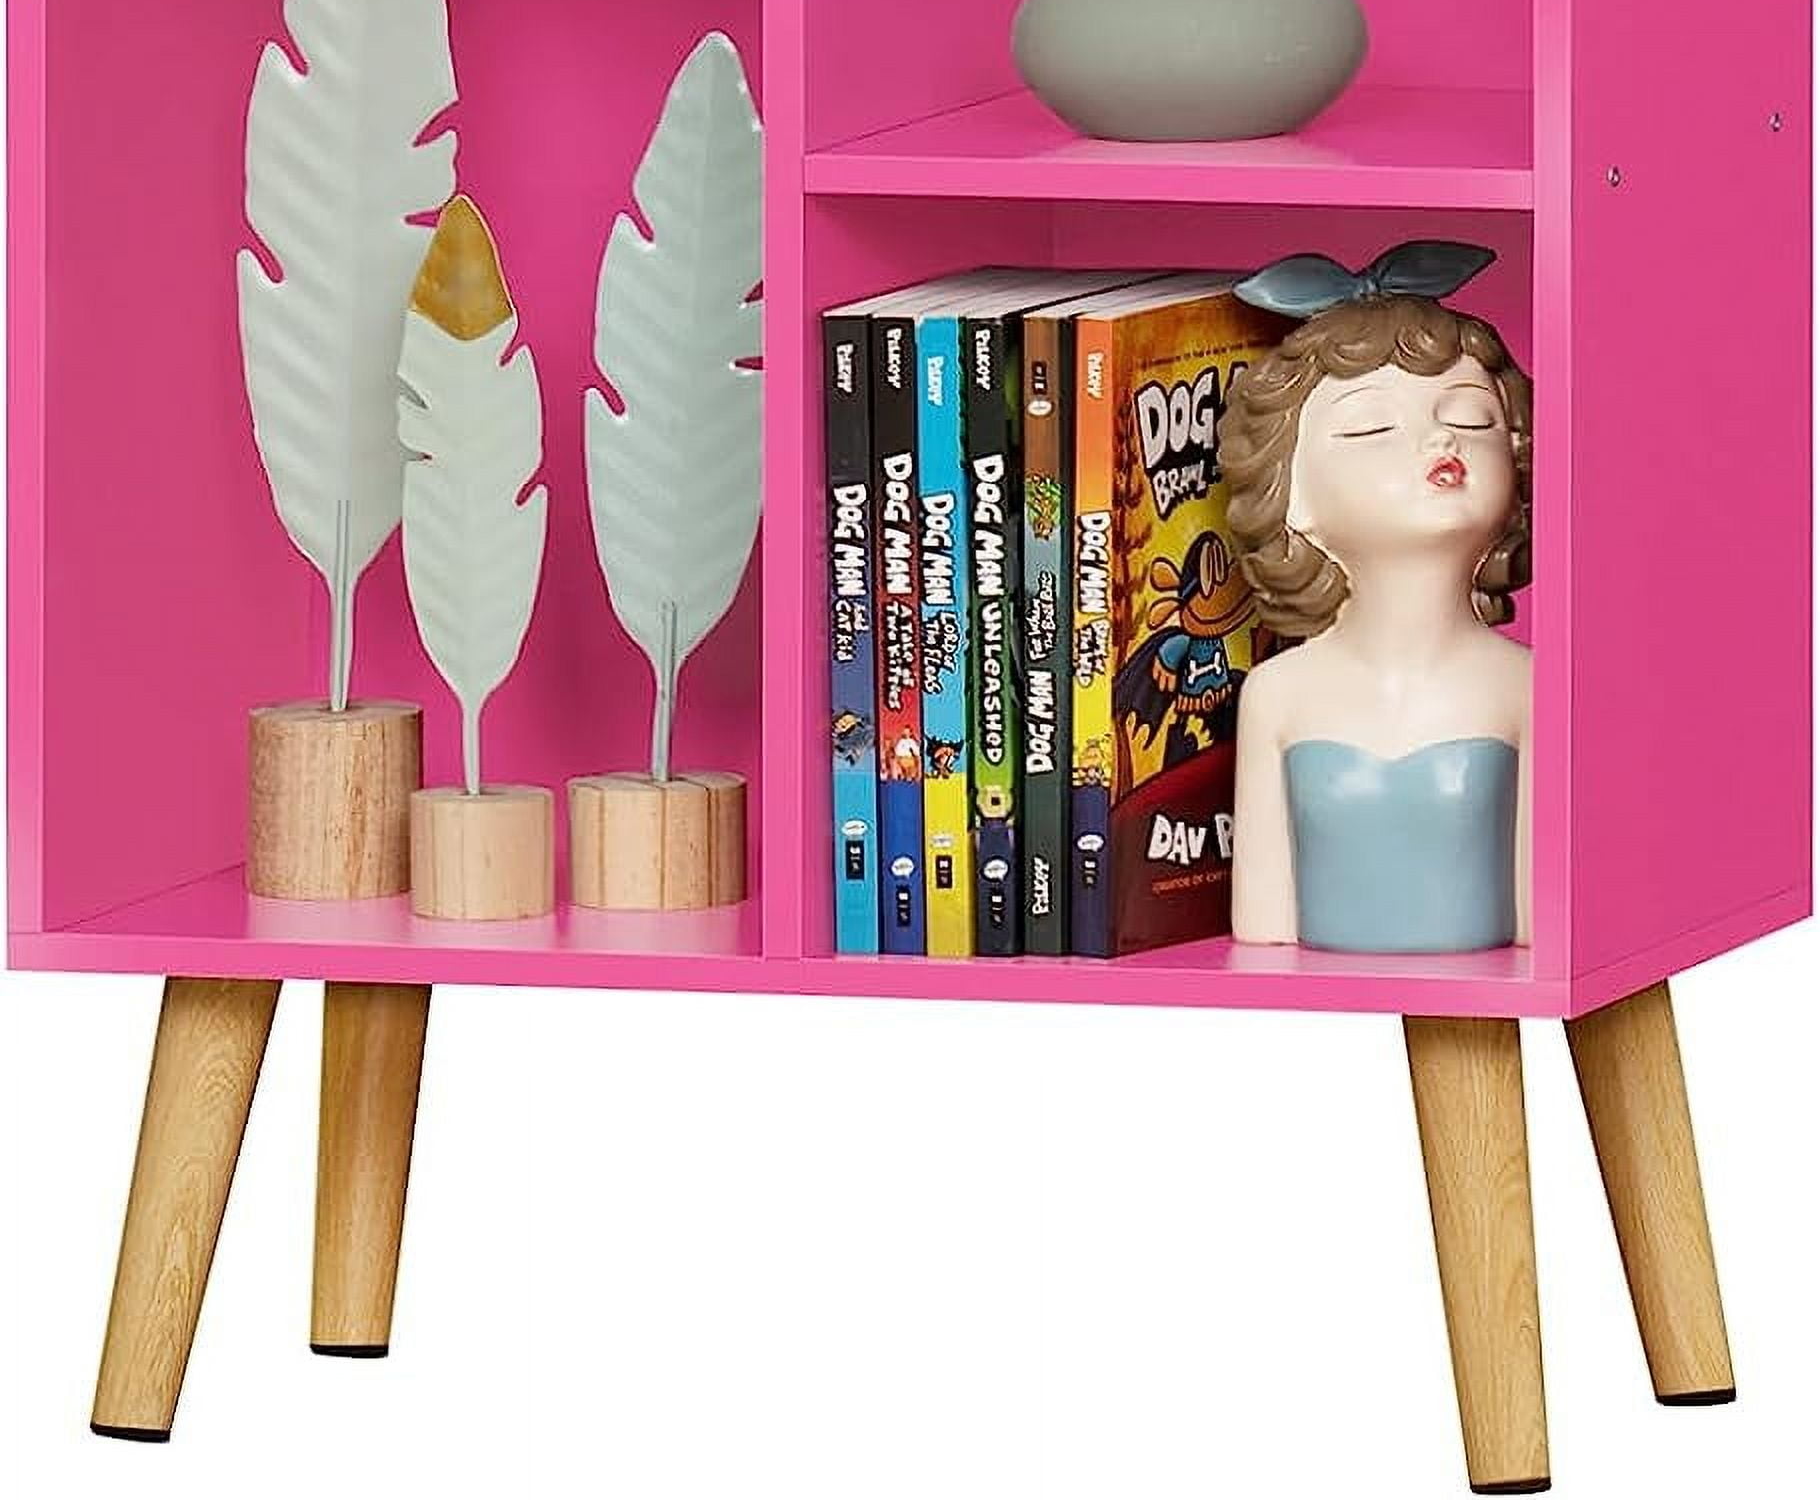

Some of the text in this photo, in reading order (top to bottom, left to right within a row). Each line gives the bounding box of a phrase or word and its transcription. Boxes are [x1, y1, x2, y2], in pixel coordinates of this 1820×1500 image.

[1138, 371, 1215, 469] DOG
[883, 452, 913, 594] DOG MAN
[973, 454, 1004, 523] DOG
[833, 484, 867, 596] DOG MAN
[922, 494, 954, 605] DOG MAN
[974, 529, 1005, 596] MAN
[1080, 513, 1111, 613] DOG MAN
[835, 599, 852, 632] CAT
[900, 605, 912, 618] A
[1027, 671, 1055, 774] DOG MAN
[1147, 813, 1207, 865] DAV
